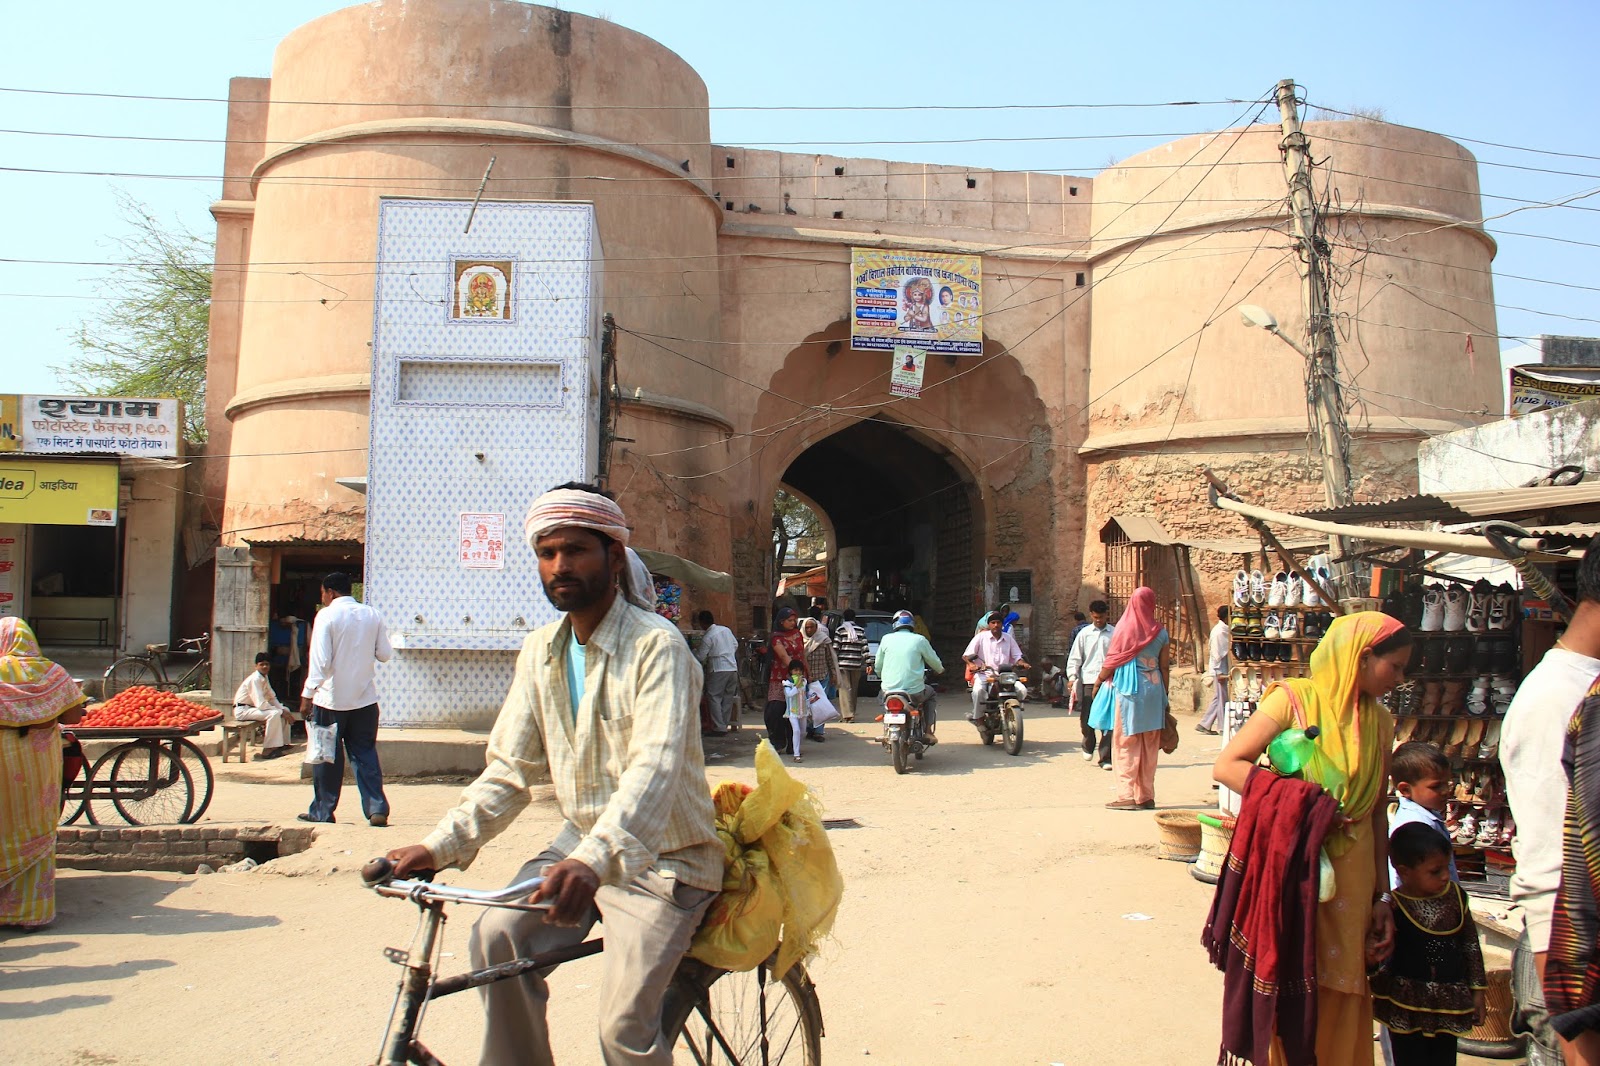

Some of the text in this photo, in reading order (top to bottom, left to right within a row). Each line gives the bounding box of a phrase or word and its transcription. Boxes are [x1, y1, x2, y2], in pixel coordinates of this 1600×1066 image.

[869, 268, 885, 280] विशाल
[38, 399, 160, 418] श्याम
[93, 419, 133, 435] फैक्स,
[37, 437, 51, 448] एक
[53, 437, 74, 448] मिनट
[86, 437, 116, 449] पासपोर्ट
[119, 437, 139, 449] फोटो
[39, 478, 78, 491] आइडिया
